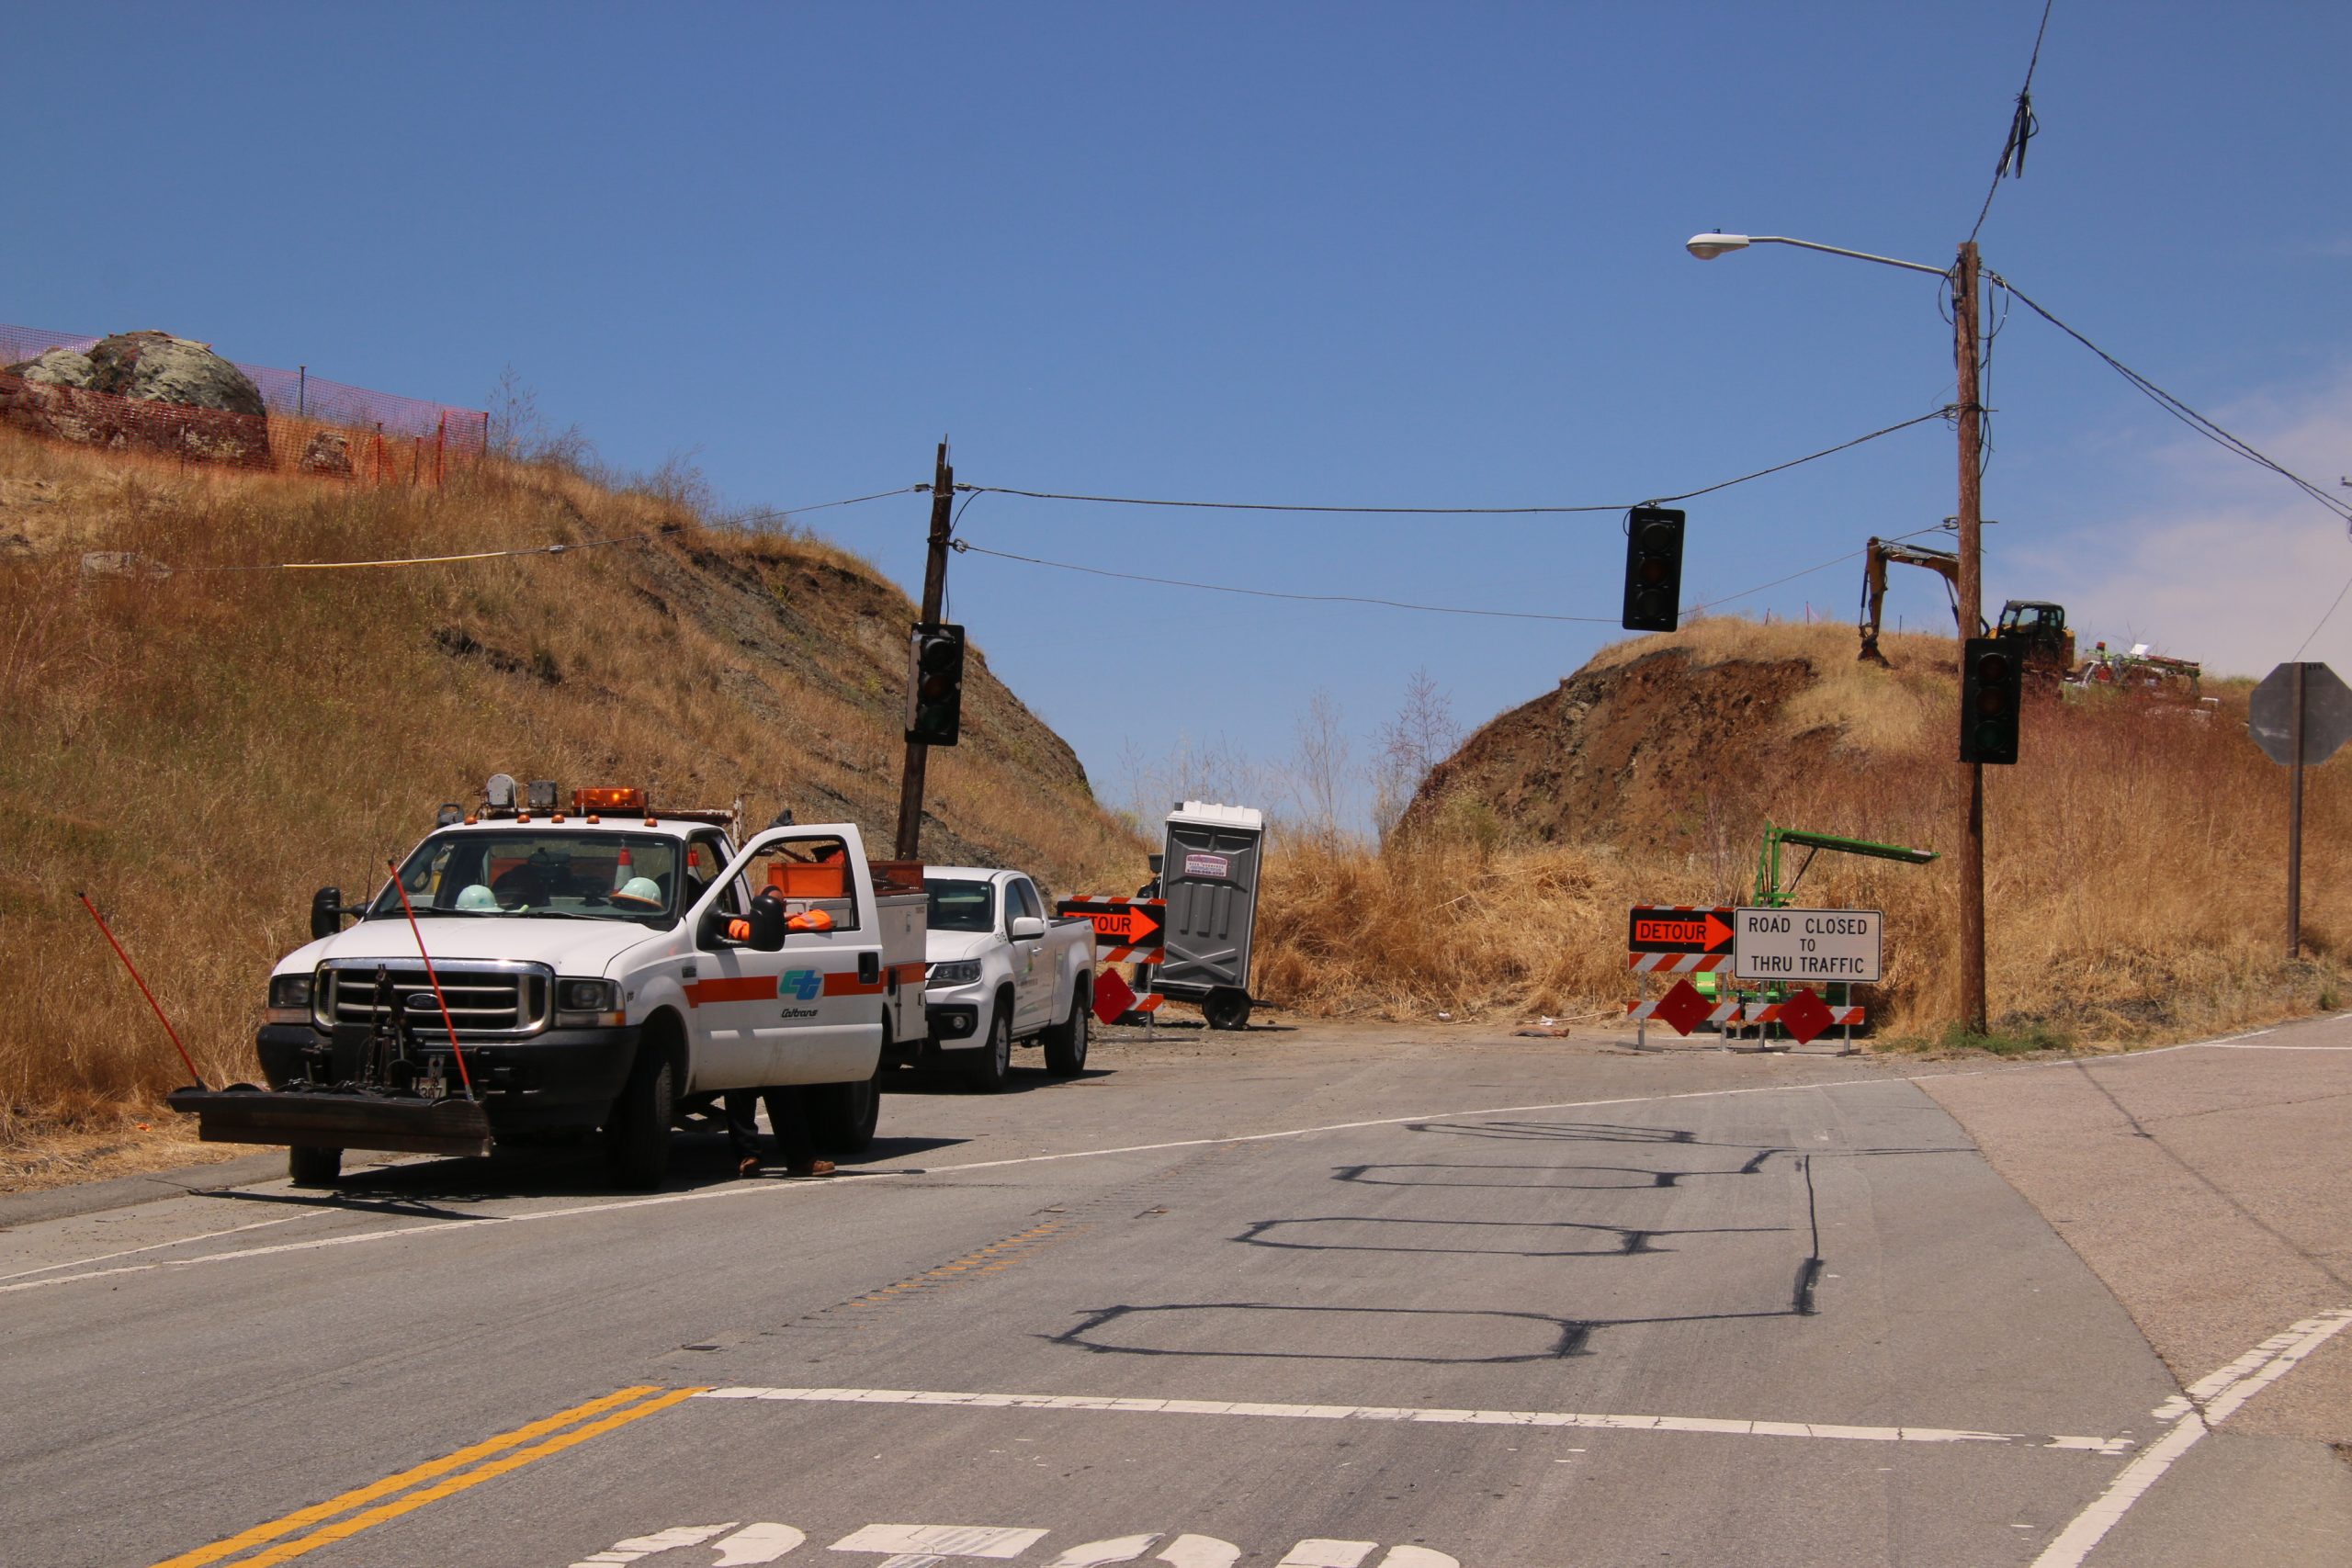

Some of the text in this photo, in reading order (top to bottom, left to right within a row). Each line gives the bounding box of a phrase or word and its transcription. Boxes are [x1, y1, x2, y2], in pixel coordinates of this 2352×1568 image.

[1067, 915, 1132, 932] TOUR
[1640, 922, 1707, 941] DETOUR
[1748, 917, 1867, 935] ROAD CLOSED
[1800, 938, 1815, 953] TO
[1751, 955, 1864, 974] THRU TRAFFIC
[781, 1008, 819, 1018] Caltrans
